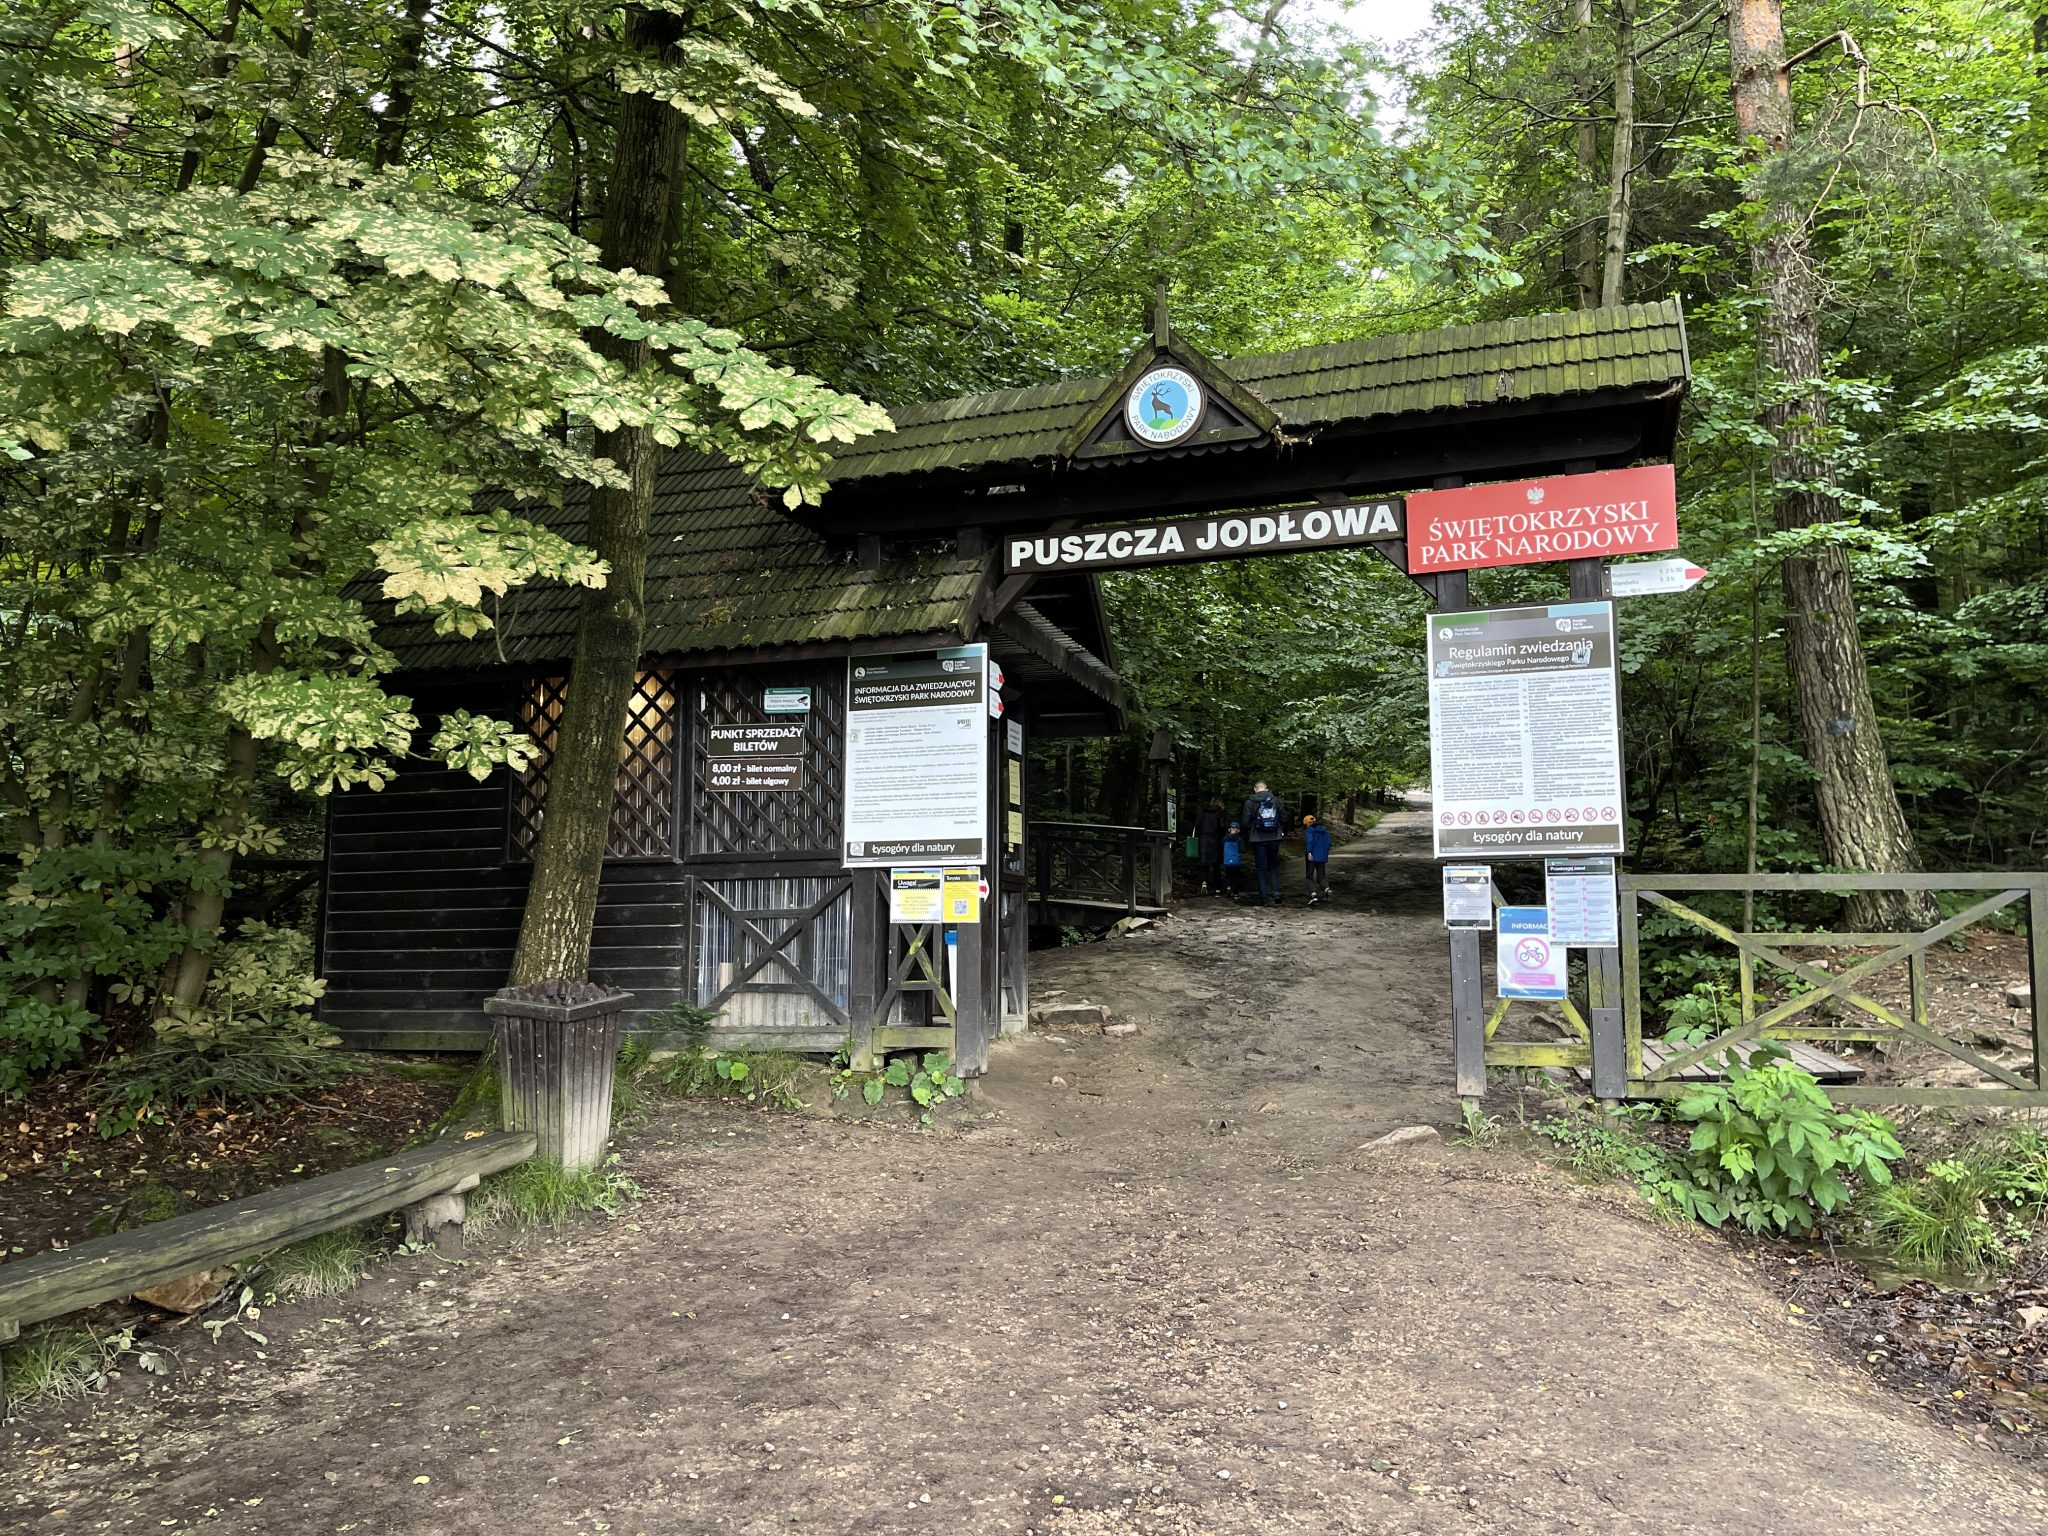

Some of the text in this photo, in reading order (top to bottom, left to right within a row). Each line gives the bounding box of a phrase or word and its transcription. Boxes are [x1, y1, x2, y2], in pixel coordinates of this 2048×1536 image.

[1132, 406, 1196, 439] PARK NARODOWY
[1429, 501, 1649, 542] ŚWIĘTOKRZYSKI
[1011, 505, 1398, 568] PUSZCZA JODŁOWA
[1420, 523, 1660, 565] PARK NARODOWY
[1449, 638, 1594, 660] Regulamin zwiedzania
[1526, 656, 1570, 664] Narodowego
[854, 679, 976, 695] INFORMACJA DLA ZWIEDZAJĄCYCH
[854, 689, 975, 704] ŚWIĘTOKRZYSKI PARK NARODOWY
[710, 726, 803, 740] PUNKT SPRZEDAŻY
[733, 739, 778, 752] BILETÓW
[712, 763, 731, 774] 8,00
[732, 763, 742, 772] zł
[746, 764, 763, 773] bilet
[763, 764, 797, 774] normalny
[711, 776, 731, 786] 4,00
[731, 775, 741, 785] zł
[745, 777, 762, 785] bilet
[763, 777, 789, 787] ulgowy
[1473, 830, 1584, 844] Łysogóry dla natury
[872, 842, 955, 855] Łysogóry dla natury
[1511, 922, 1548, 930] INFORMAC
